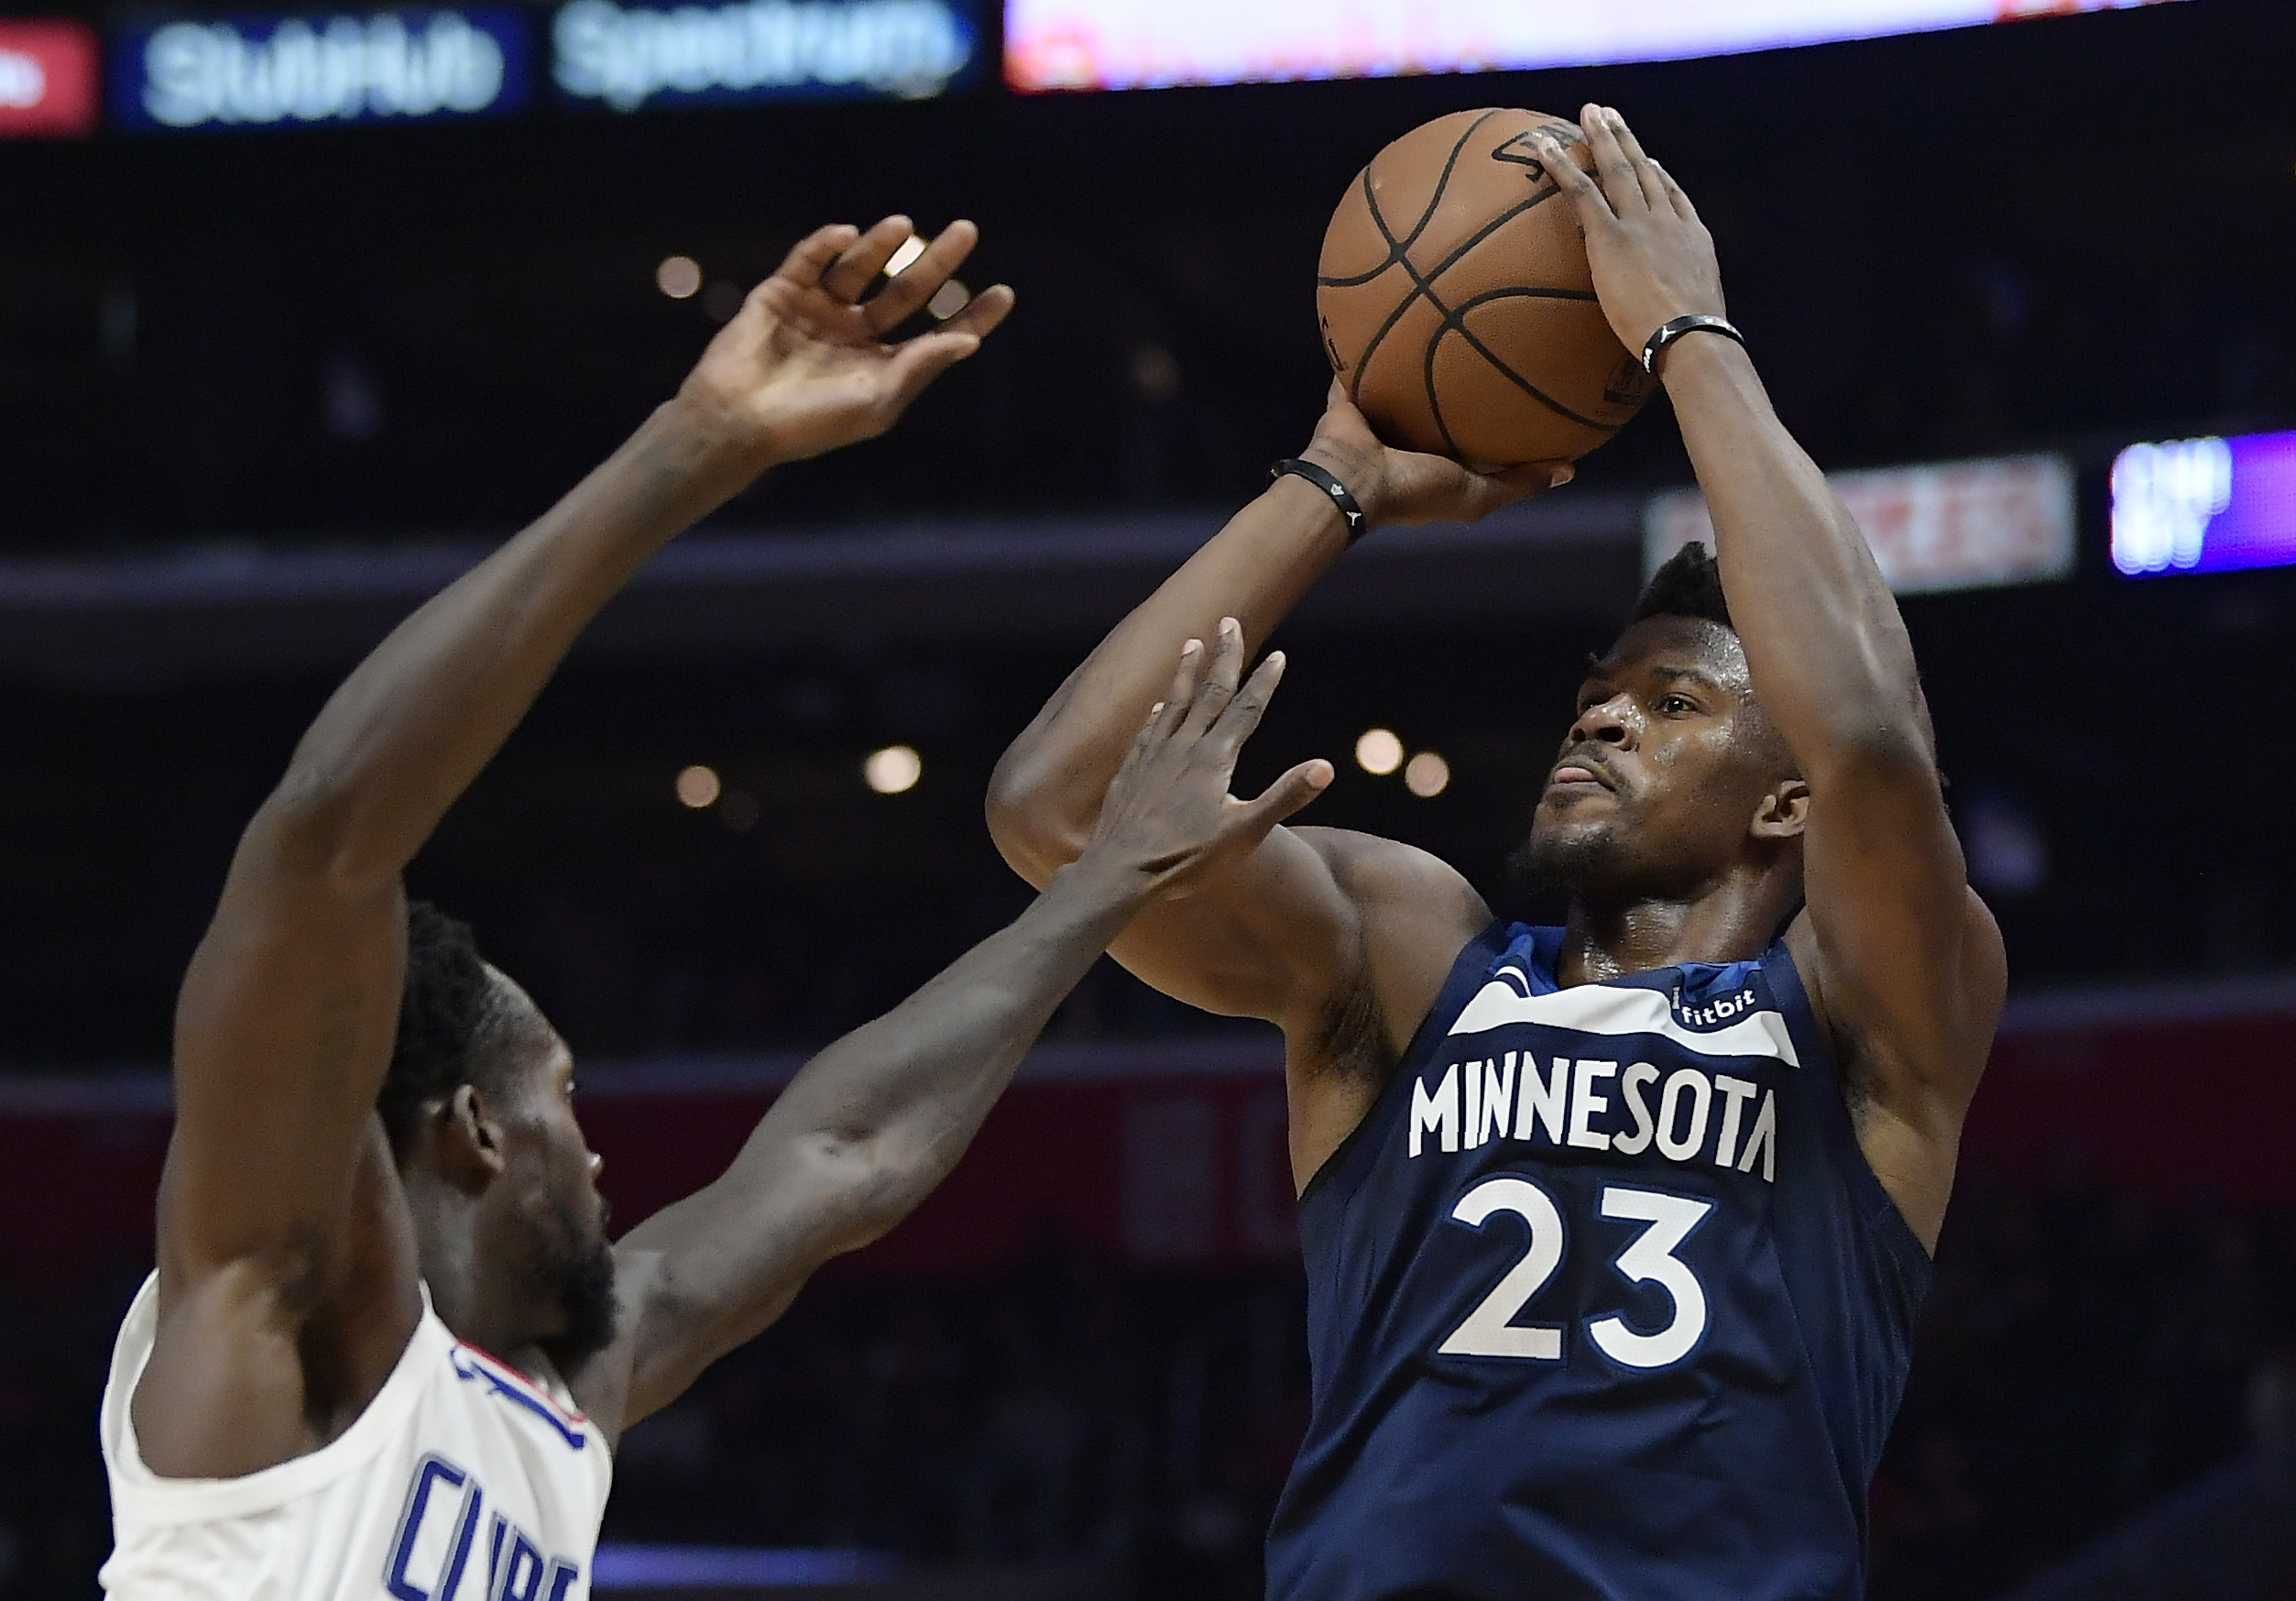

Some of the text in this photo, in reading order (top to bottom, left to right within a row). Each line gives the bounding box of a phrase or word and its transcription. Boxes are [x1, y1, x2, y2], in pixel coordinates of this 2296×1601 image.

[1681, 990, 1755, 1025] fitbit
[1409, 1051, 1776, 1182] MINNESOTA
[1438, 1179, 1711, 1367] 23
